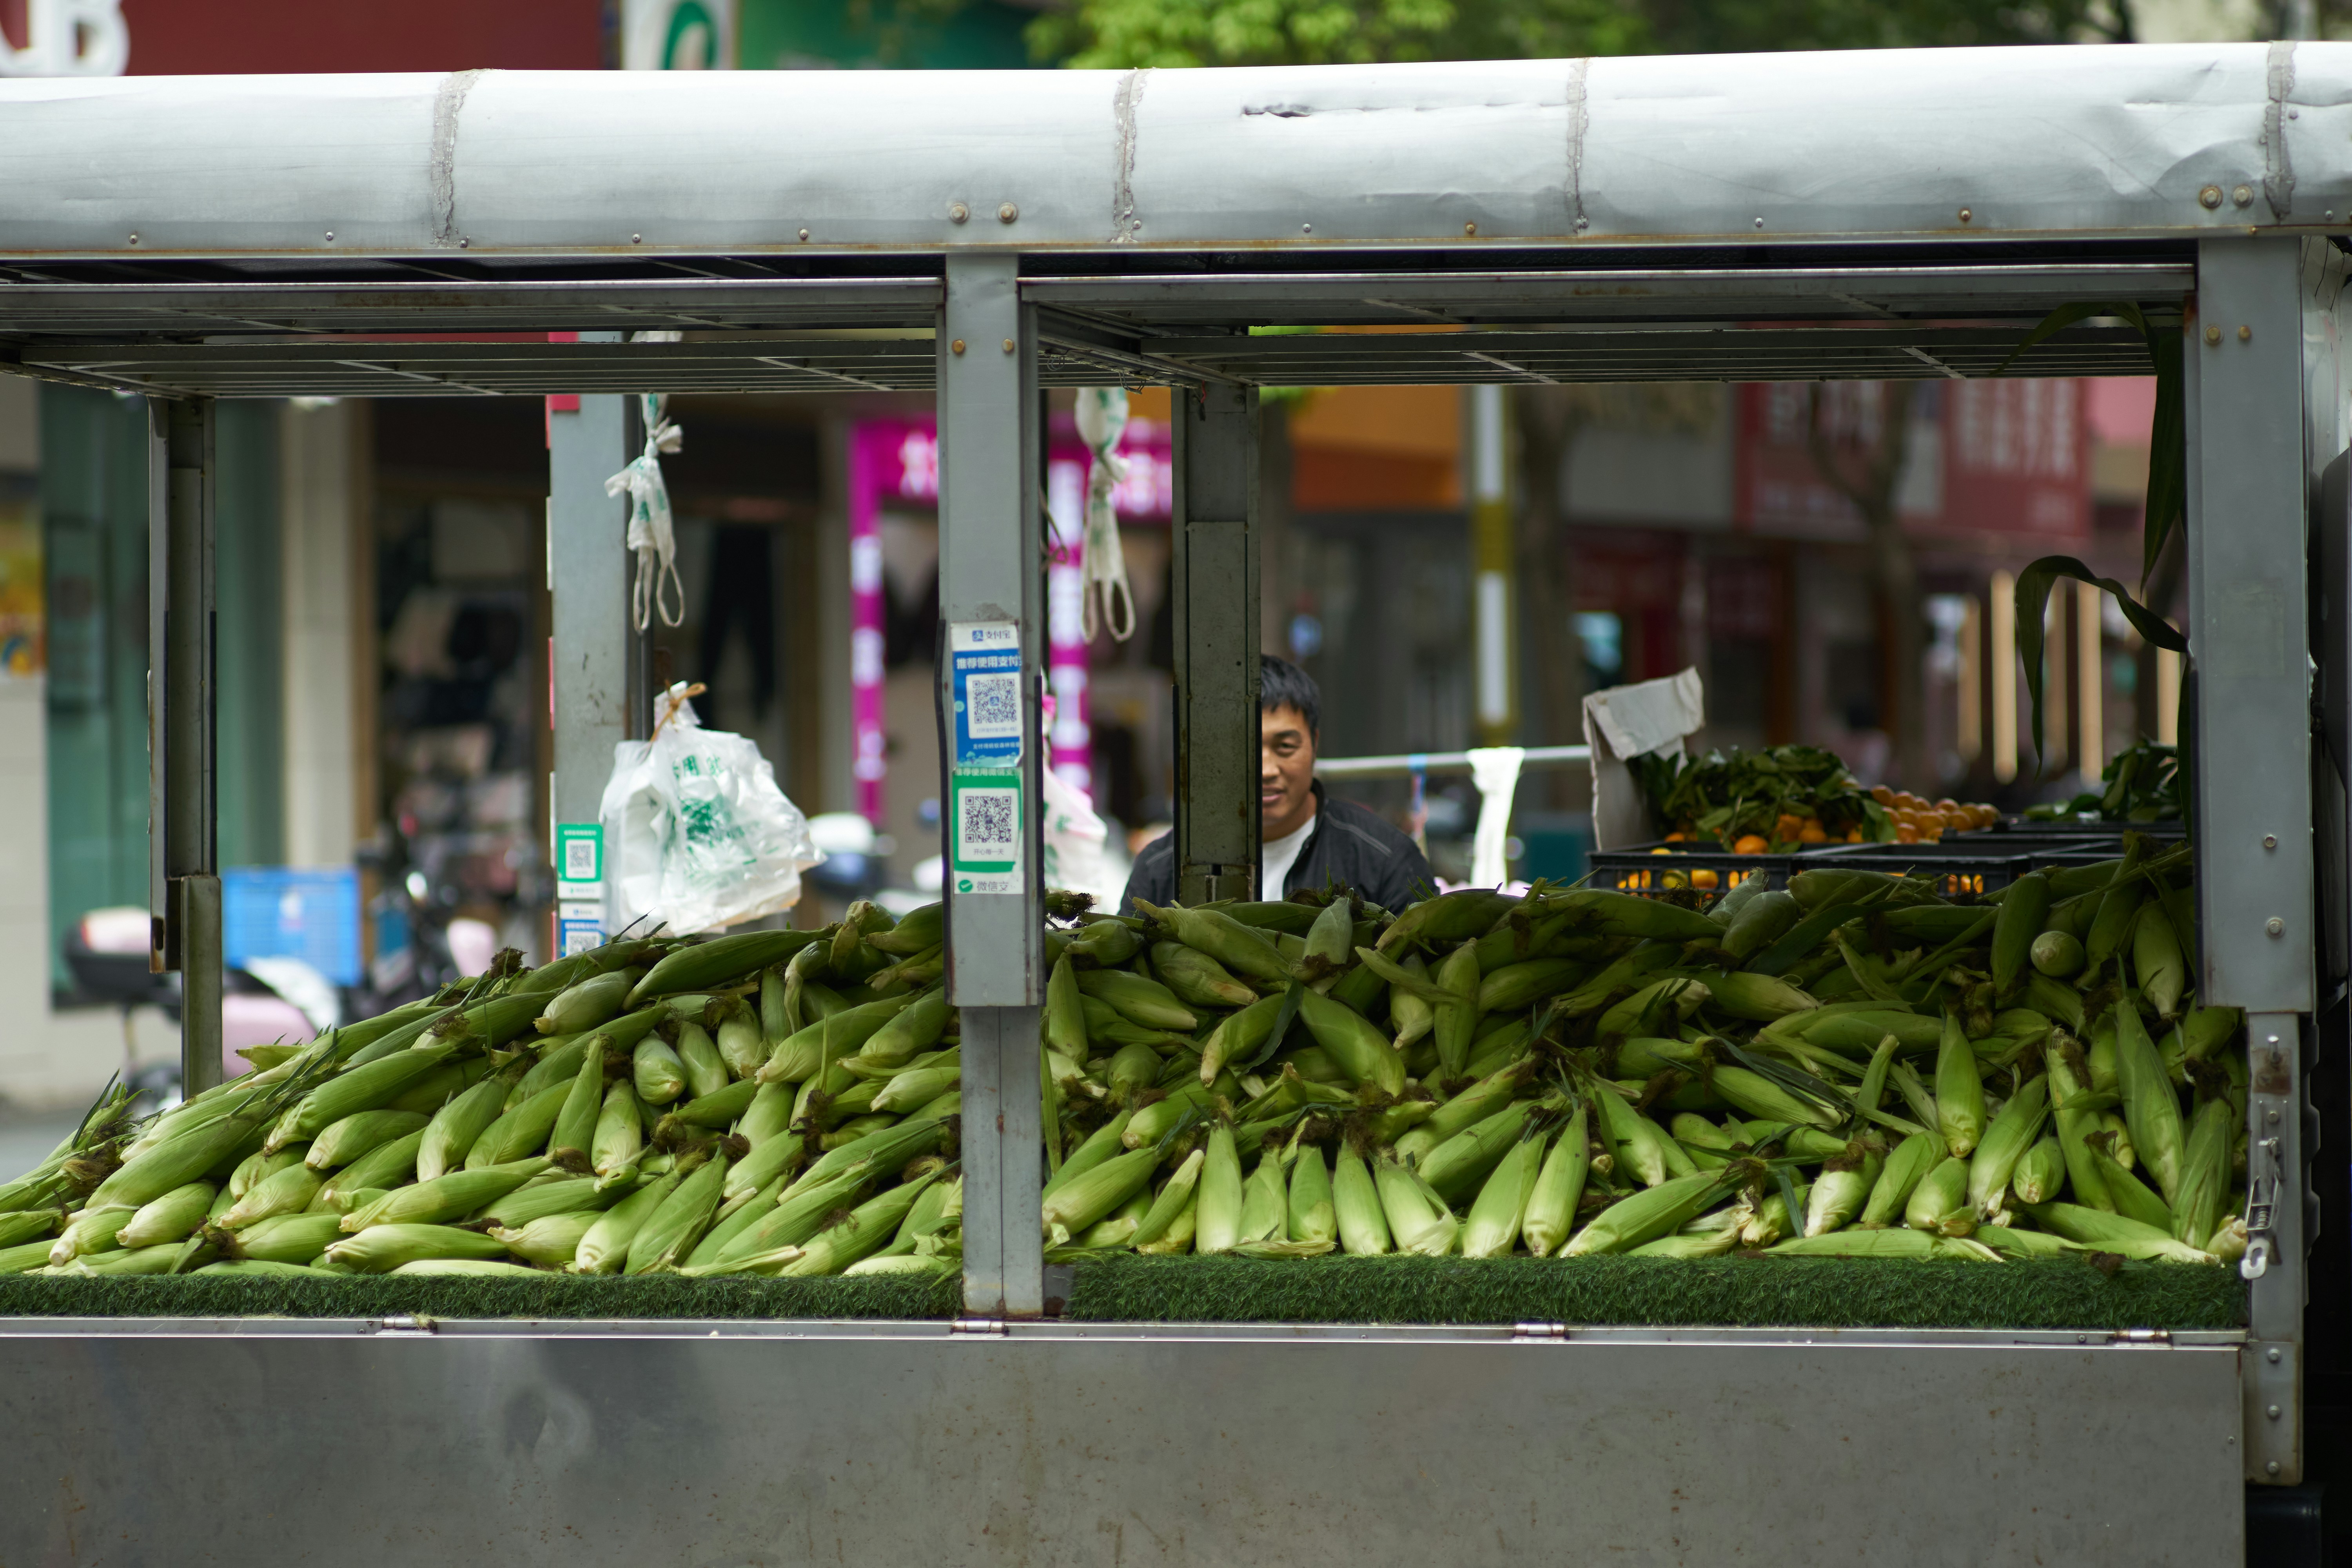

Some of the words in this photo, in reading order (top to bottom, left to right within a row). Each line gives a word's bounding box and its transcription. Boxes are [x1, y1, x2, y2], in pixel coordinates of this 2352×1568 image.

[985, 630, 1010, 640] 支付宝
[977, 881, 1015, 892] 微信支
